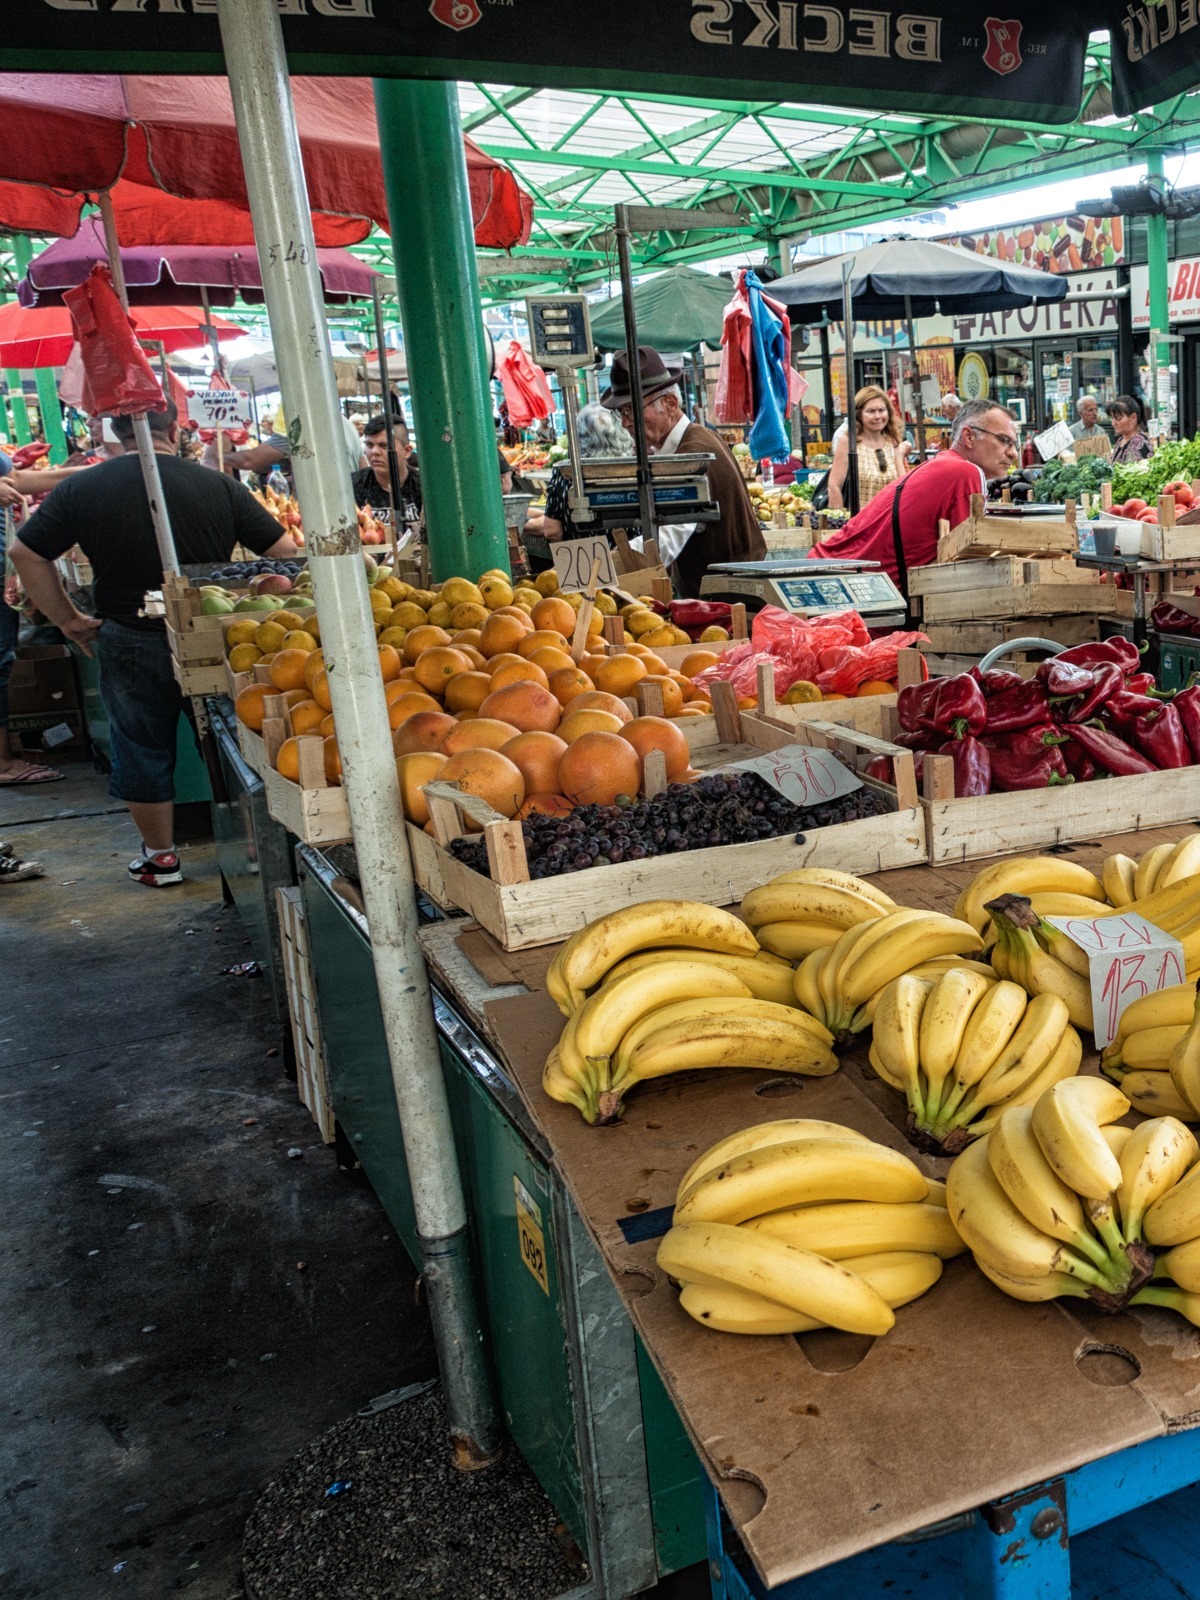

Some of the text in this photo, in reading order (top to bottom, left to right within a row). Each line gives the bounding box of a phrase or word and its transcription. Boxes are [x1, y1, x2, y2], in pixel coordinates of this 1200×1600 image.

[556, 541, 613, 589] 200
[773, 755, 836, 804] 50
[522, 1228, 545, 1282] 092
